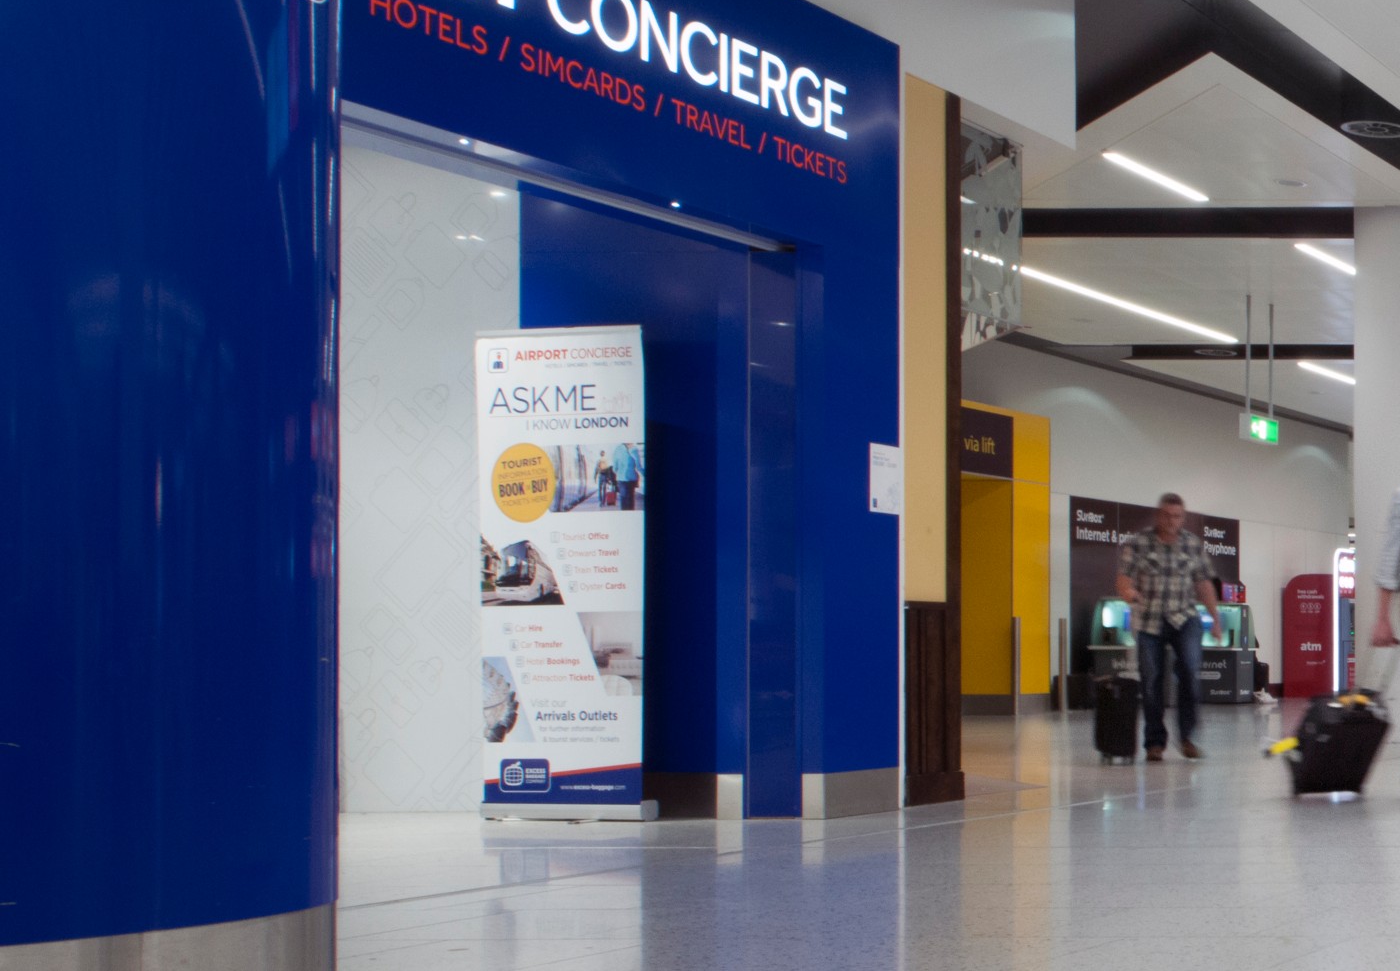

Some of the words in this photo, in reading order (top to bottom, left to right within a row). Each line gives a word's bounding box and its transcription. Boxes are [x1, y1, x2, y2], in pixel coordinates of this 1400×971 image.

[520, 43, 646, 112] SIMCARDS
[672, 98, 751, 149] TRAVEL
[773, 136, 847, 184] TICKETS
[515, 349, 568, 361] AIRPORT
[570, 346, 632, 359] CONCIERGE
[489, 386, 550, 414] ASK
[556, 384, 596, 412] ME
[532, 418, 571, 430] KNOW
[575, 416, 629, 429] LONDON
[964, 435, 979, 452] via
[981, 436, 996, 455] lift
[501, 457, 542, 469] TOURIST
[499, 482, 525, 497] BOOK
[532, 478, 548, 493] BUY
[588, 532, 609, 540] Office
[1076, 527, 1110, 542] Internet
[1111, 530, 1117, 543] &
[598, 549, 619, 557] Travel
[1204, 541, 1236, 556] Payphone
[594, 565, 618, 573] Tickets
[606, 582, 626, 590] Cards
[1300, 641, 1322, 652] atm
[546, 658, 580, 666] Bookings
[536, 711, 576, 721] Arrivals
[579, 711, 618, 721] Outlets
